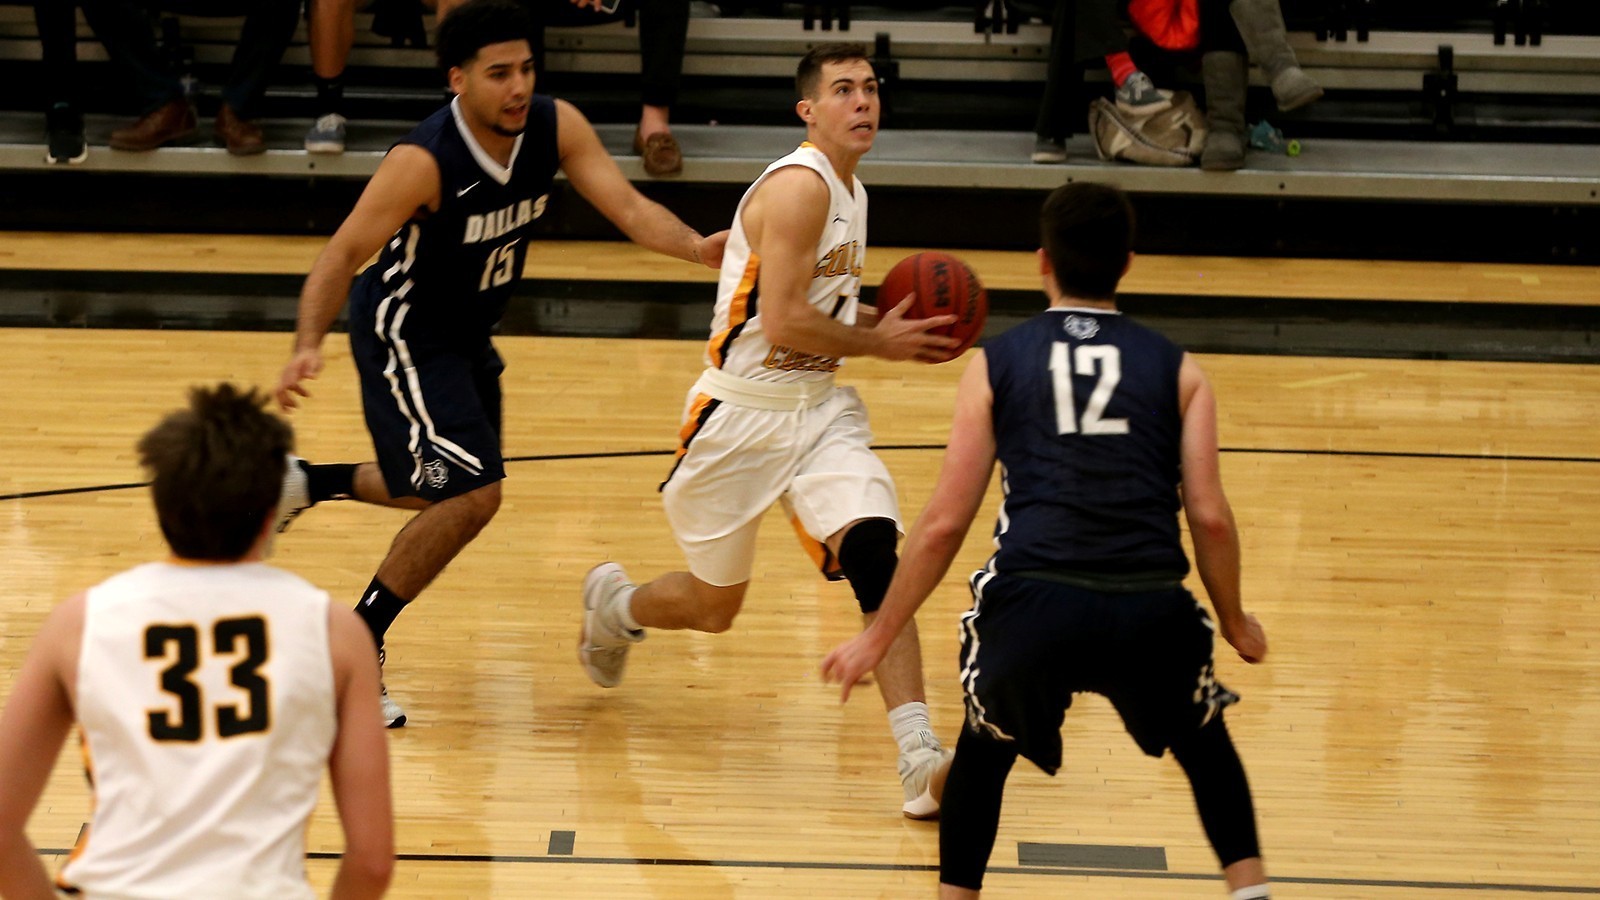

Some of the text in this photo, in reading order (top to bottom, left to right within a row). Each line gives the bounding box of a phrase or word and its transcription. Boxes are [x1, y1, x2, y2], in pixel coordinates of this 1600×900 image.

[463, 194, 549, 243] DALLAS
[479, 237, 521, 292] 15
[1048, 341, 1130, 435] 12
[143, 614, 271, 744] 33
